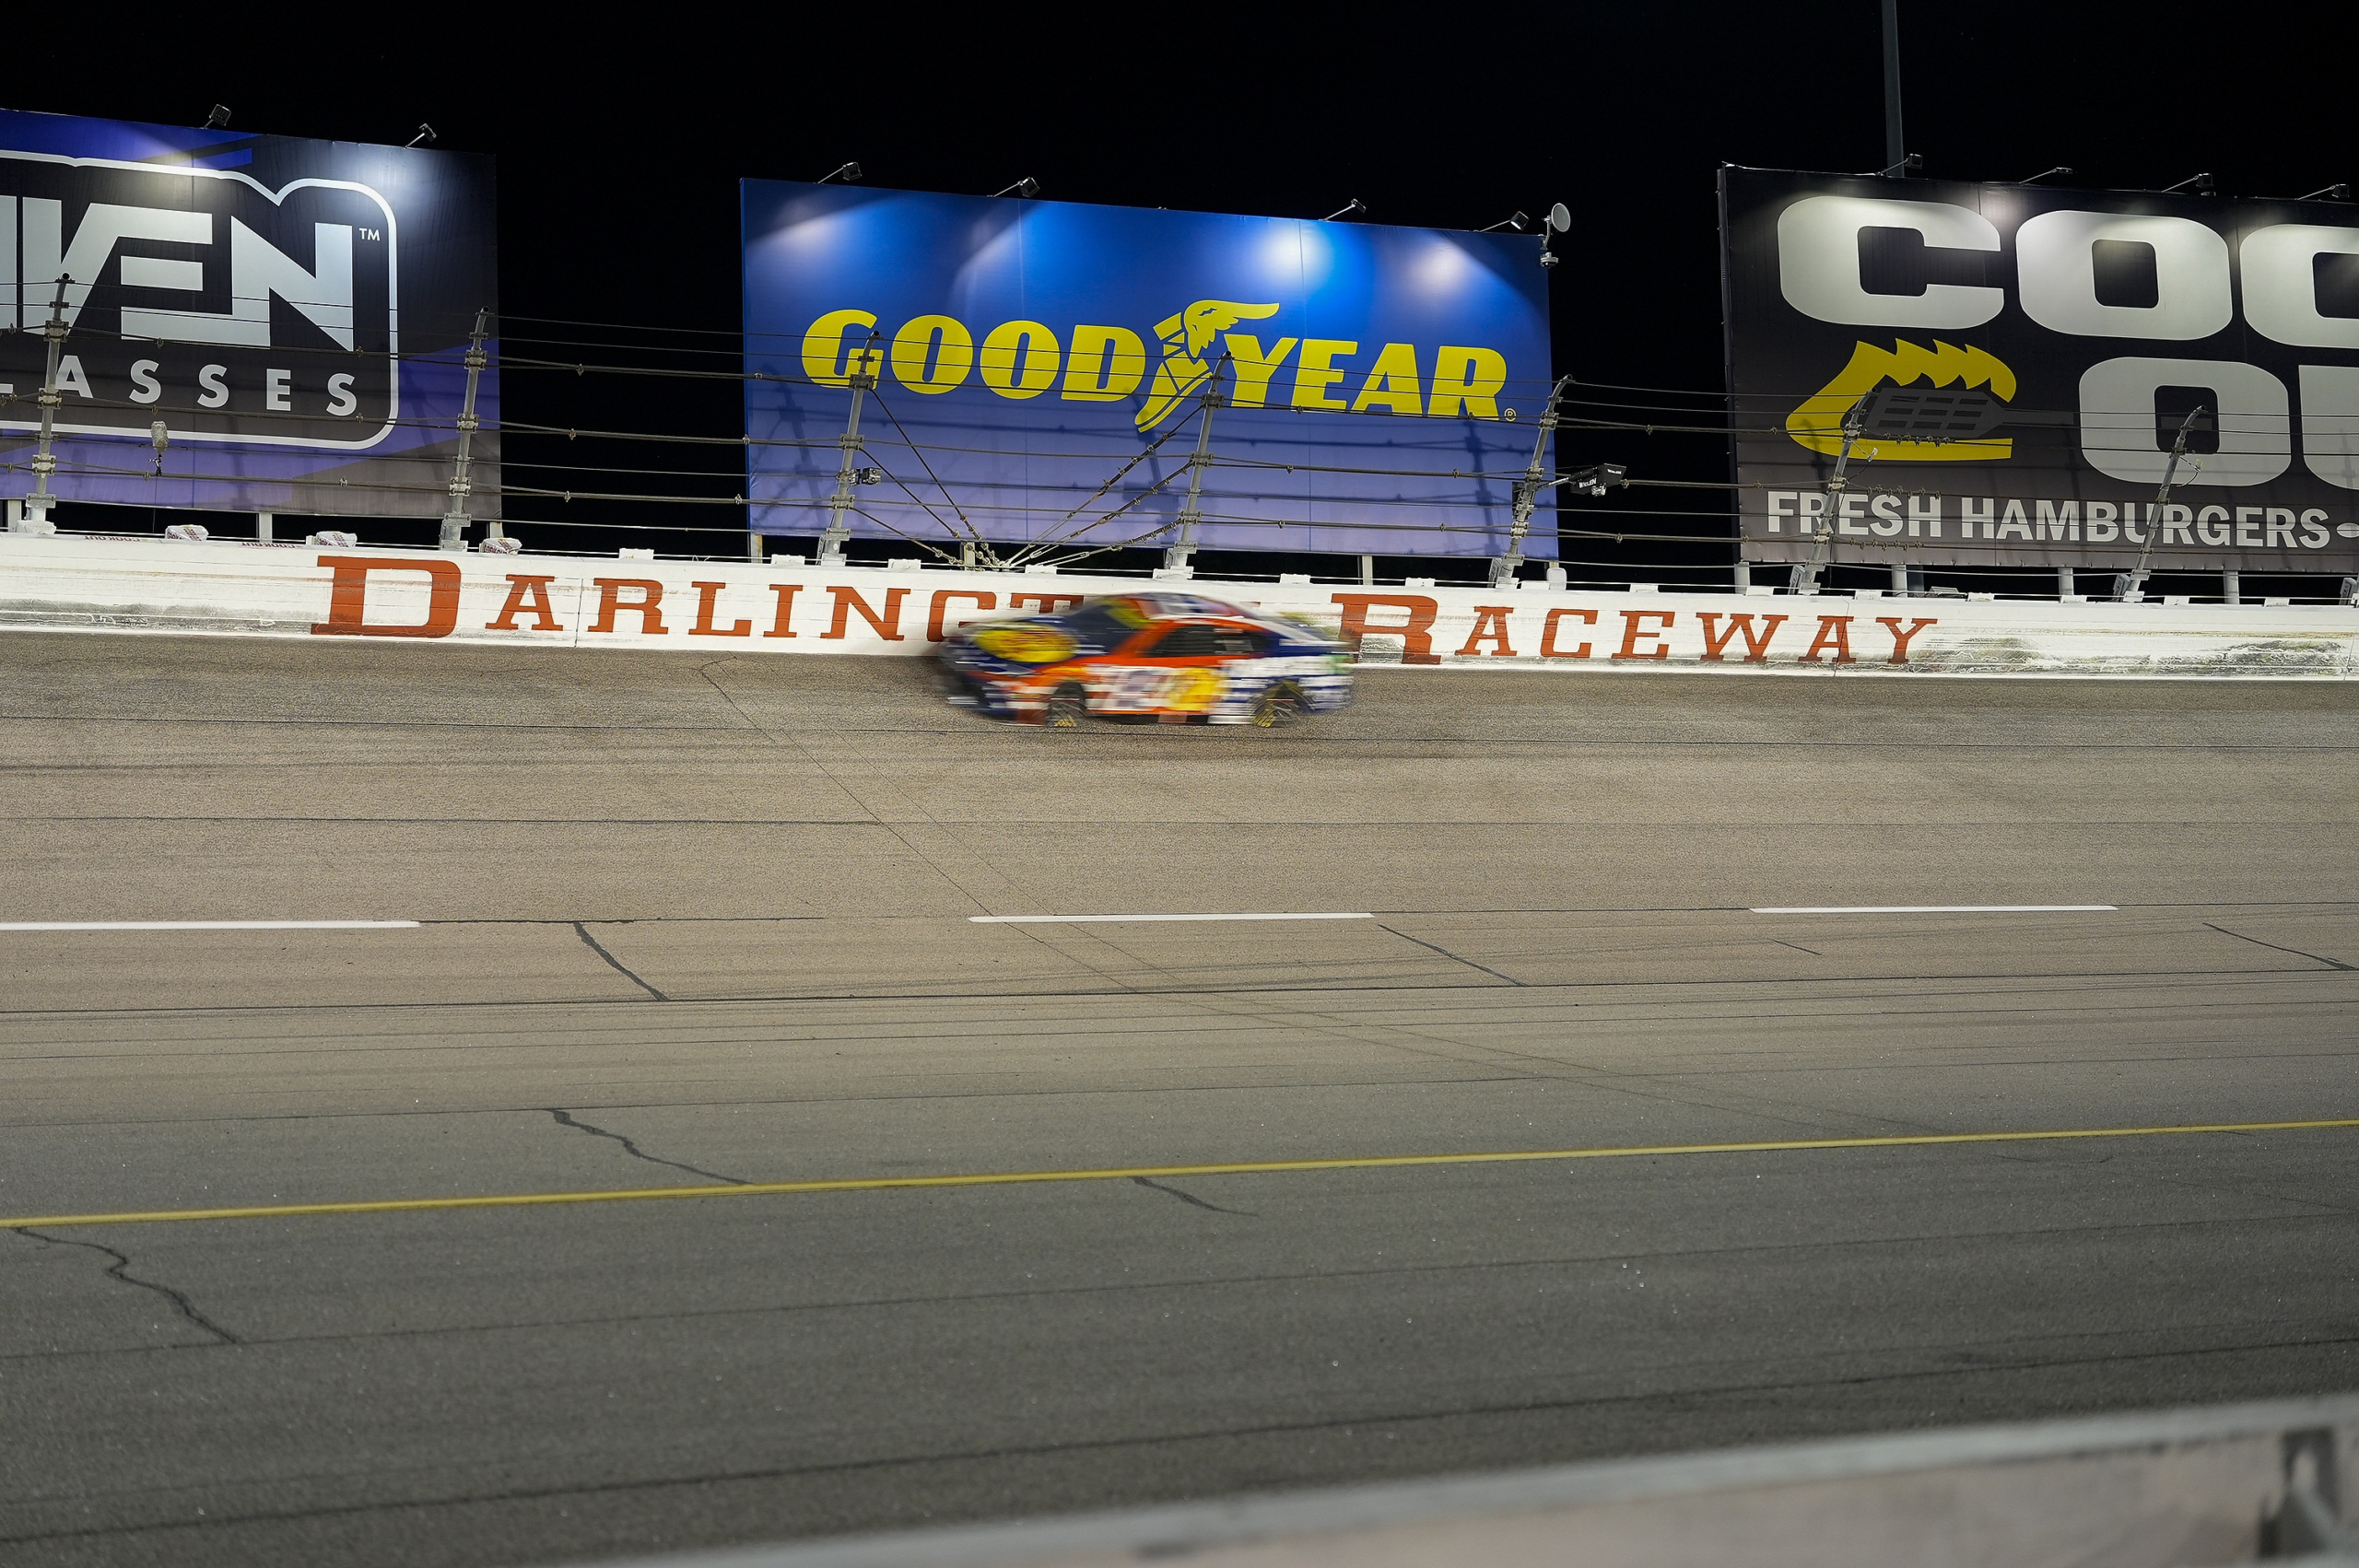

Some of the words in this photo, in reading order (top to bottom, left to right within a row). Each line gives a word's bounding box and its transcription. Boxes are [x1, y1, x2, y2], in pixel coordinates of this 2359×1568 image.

[359, 228, 381, 241] TM
[2079, 357, 2359, 491] O
[1767, 490, 1942, 537] FRESH
[1961, 497, 2330, 549] HAMBURGERS
[310, 555, 1085, 642] DARLINGT
[1331, 592, 1938, 664] RACEWAY
